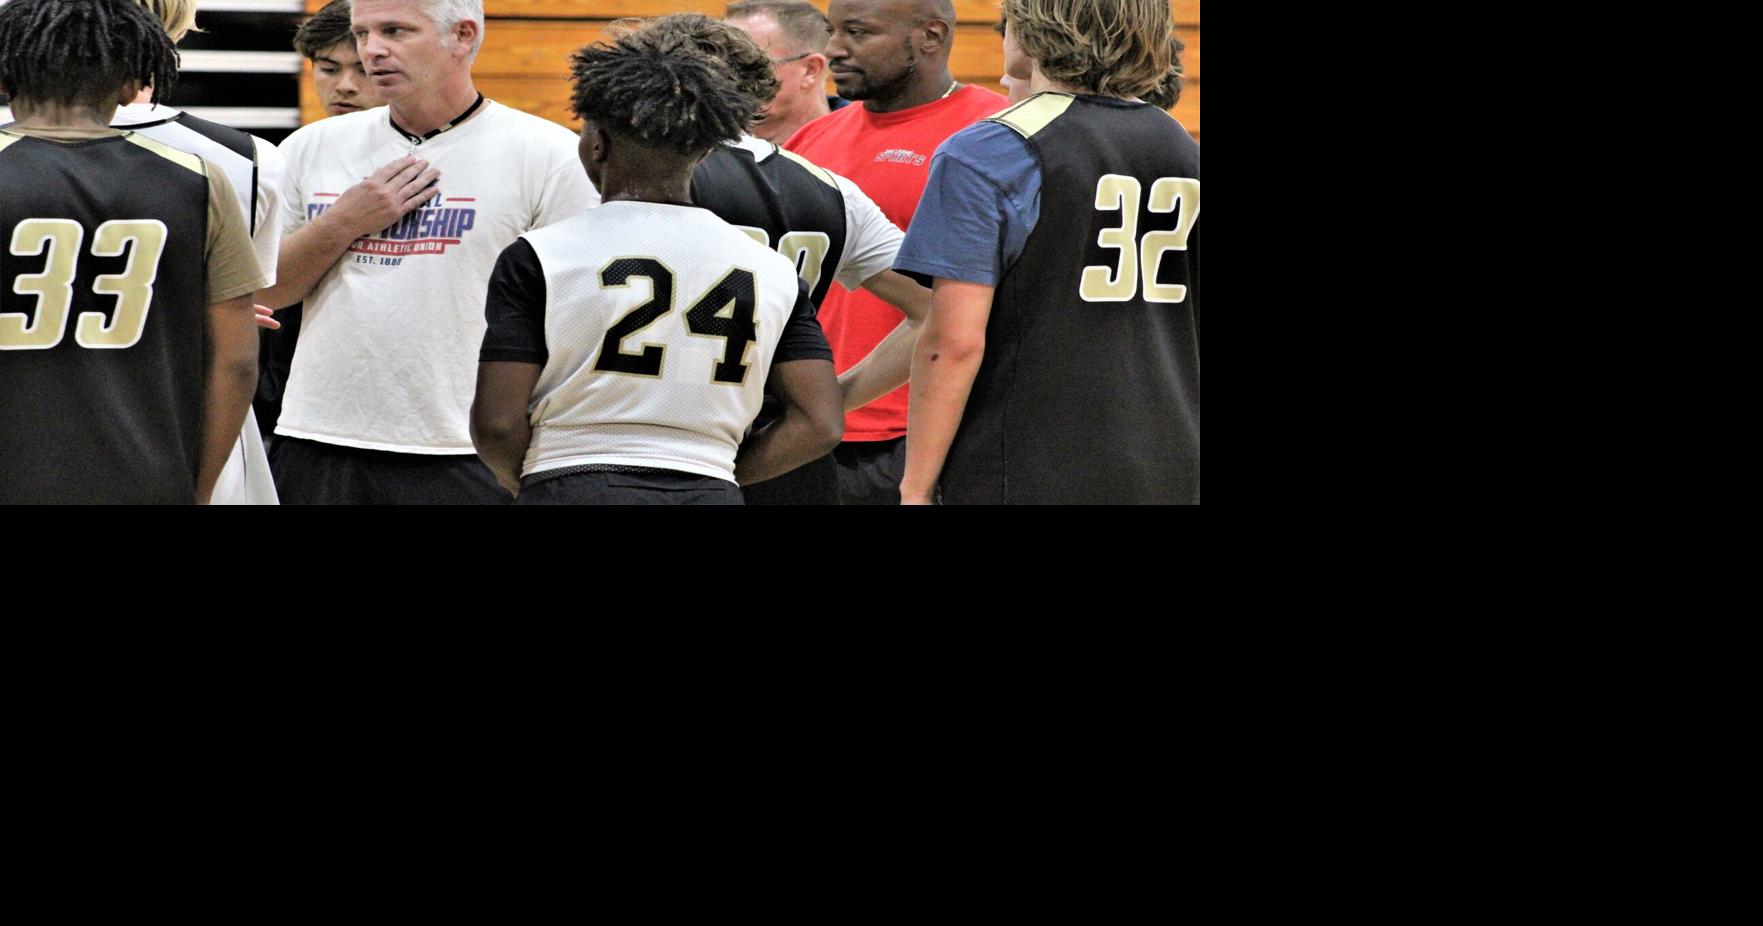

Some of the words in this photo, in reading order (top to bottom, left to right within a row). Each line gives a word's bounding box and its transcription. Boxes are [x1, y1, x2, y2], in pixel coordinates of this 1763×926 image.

[0, 218, 168, 349] 33
[356, 255, 376, 265] EST.
[379, 256, 402, 266] 1888
[366, 242, 412, 253] ATHLETIC
[414, 242, 442, 252] UNION
[1079, 173, 1200, 303] 32
[592, 255, 760, 387] 24
